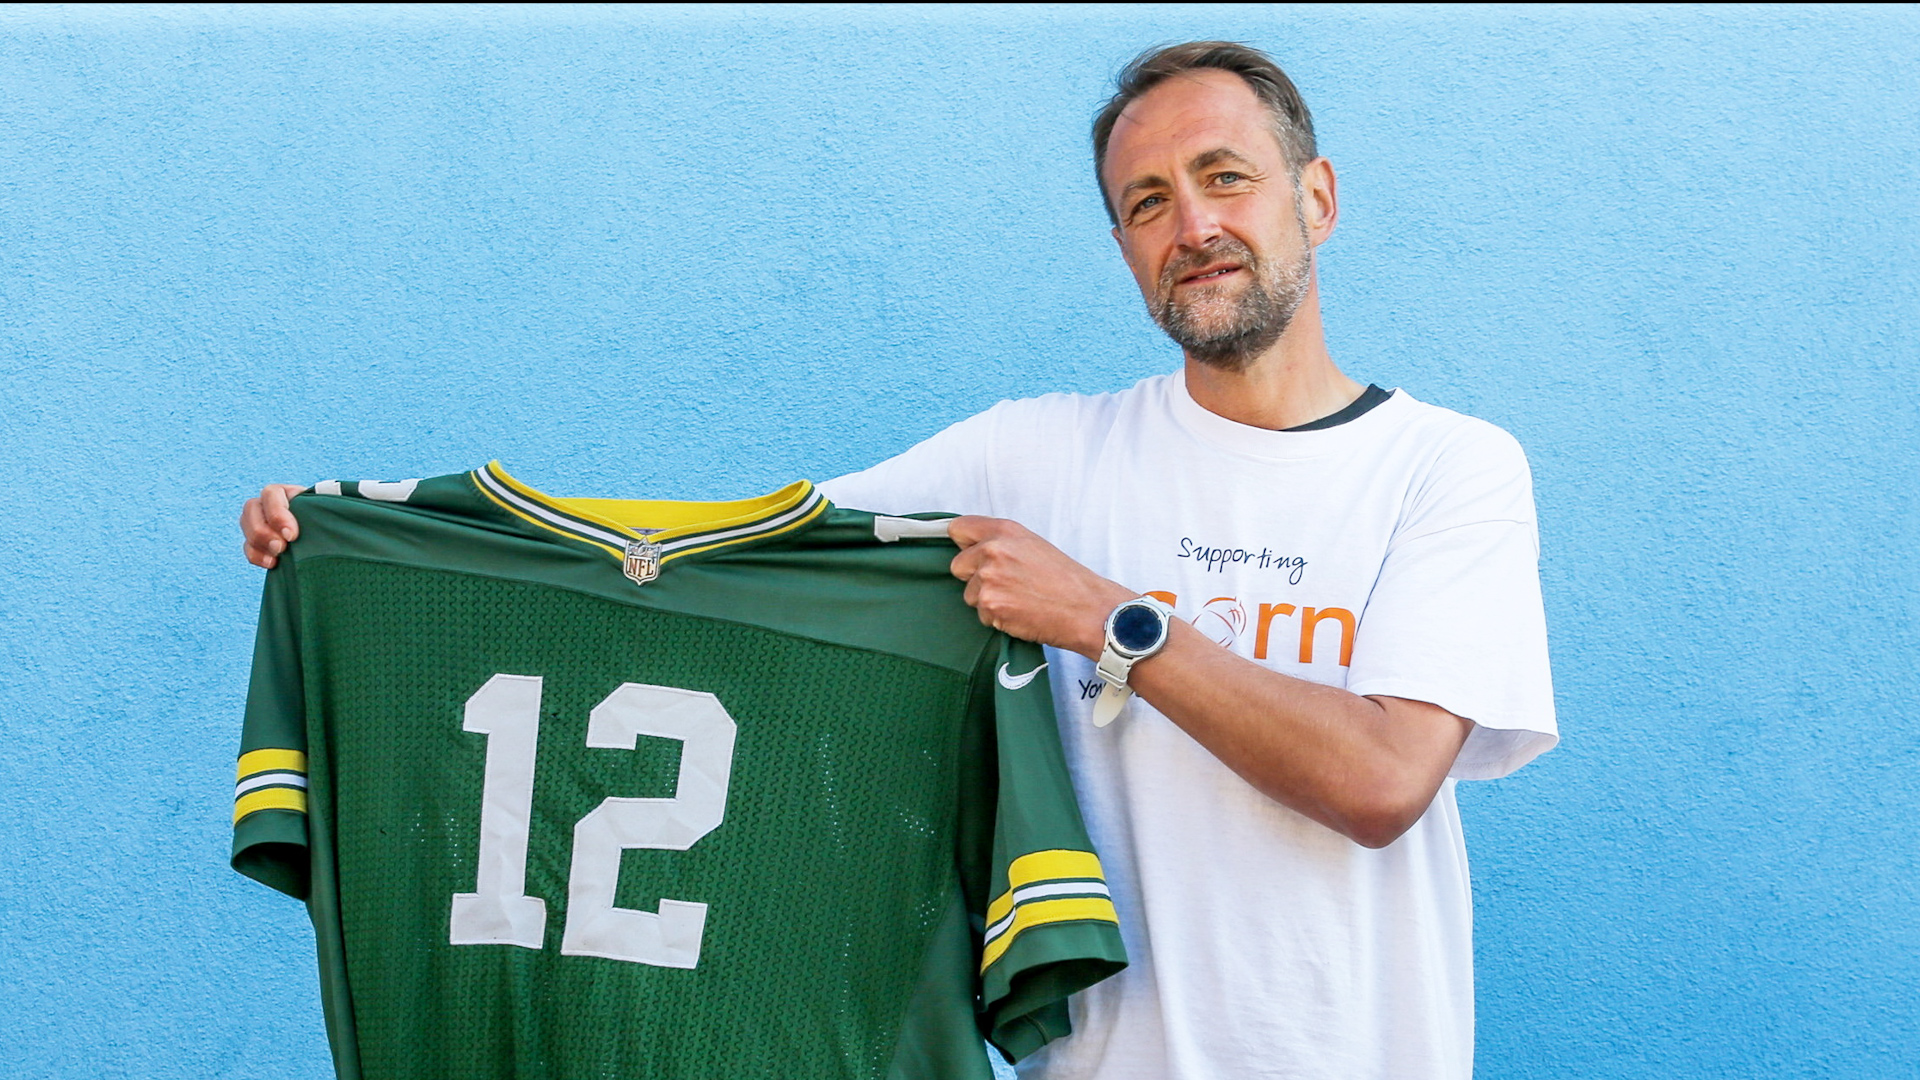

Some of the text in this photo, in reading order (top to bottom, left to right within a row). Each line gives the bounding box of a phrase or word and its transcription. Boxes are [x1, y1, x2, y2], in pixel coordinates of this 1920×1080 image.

[628, 557, 654, 577] NFL
[1177, 537, 1308, 585] Supporting
[450, 673, 737, 969] 12
